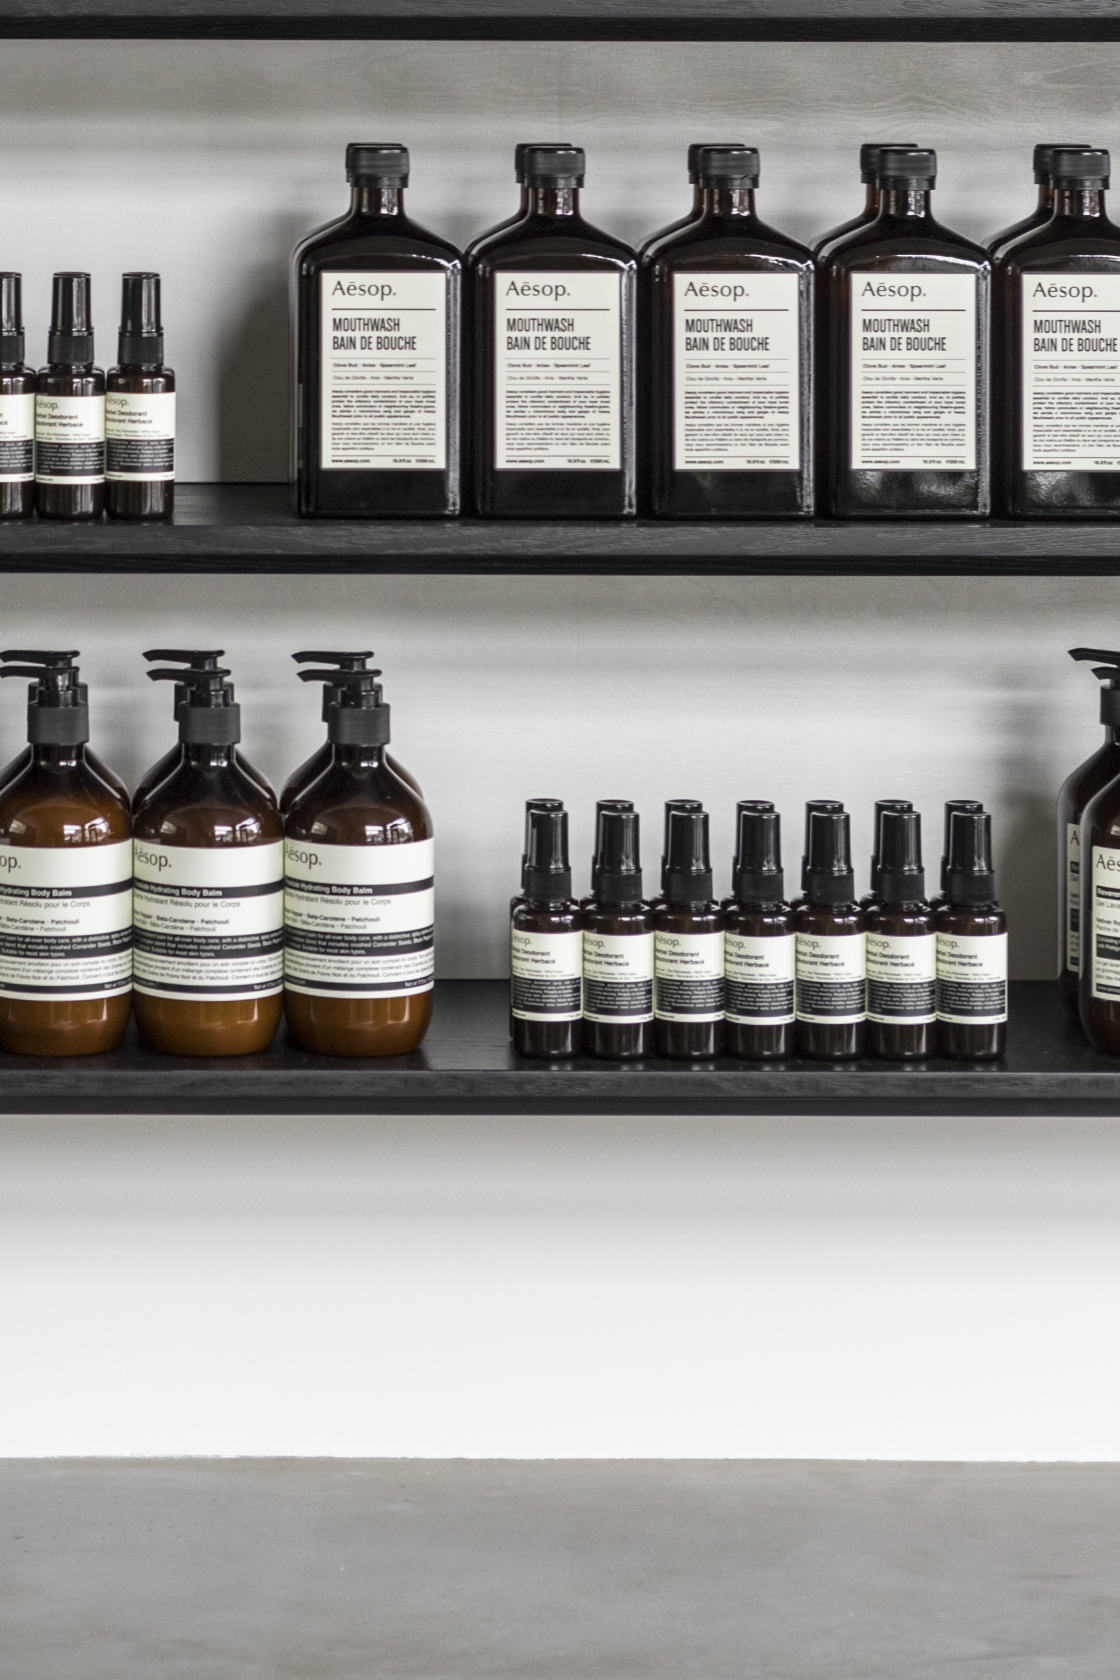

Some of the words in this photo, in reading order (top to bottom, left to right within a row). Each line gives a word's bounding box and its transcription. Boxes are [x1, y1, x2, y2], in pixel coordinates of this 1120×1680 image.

[332, 280, 397, 302] Aēsop.
[506, 280, 571, 302] Aēsop.
[684, 281, 749, 303] Aēsop.
[861, 281, 926, 303] Aēsop.
[1033, 282, 1098, 304] Aēsop.
[333, 318, 401, 332] MOUTHWASH
[507, 318, 575, 332] MOUTHWASH
[685, 319, 753, 333] MOUTHWASH
[862, 319, 930, 333] MOUTHWASH
[1034, 320, 1102, 334] MOUTHWASH
[333, 336, 357, 350] BAIN
[361, 336, 373, 350] DE
[376, 336, 417, 351] BOUCHE
[507, 336, 531, 350] BAIN
[535, 336, 547, 350] DE
[550, 336, 591, 351] BOUCHE
[685, 337, 709, 351] BAIN
[713, 337, 725, 351] DE
[728, 337, 769, 352] BOUCHE
[862, 337, 886, 351] BAIN
[890, 337, 902, 351] DE
[905, 337, 946, 352] BOUCHE
[1034, 338, 1058, 352] BAIN
[1062, 338, 1074, 352] DE
[1077, 338, 1118, 353] BOUCHE
[30, 889, 51, 898] Body
[51, 889, 73, 897] Balm
[331, 886, 351, 895] Body
[352, 886, 373, 894] Balm
